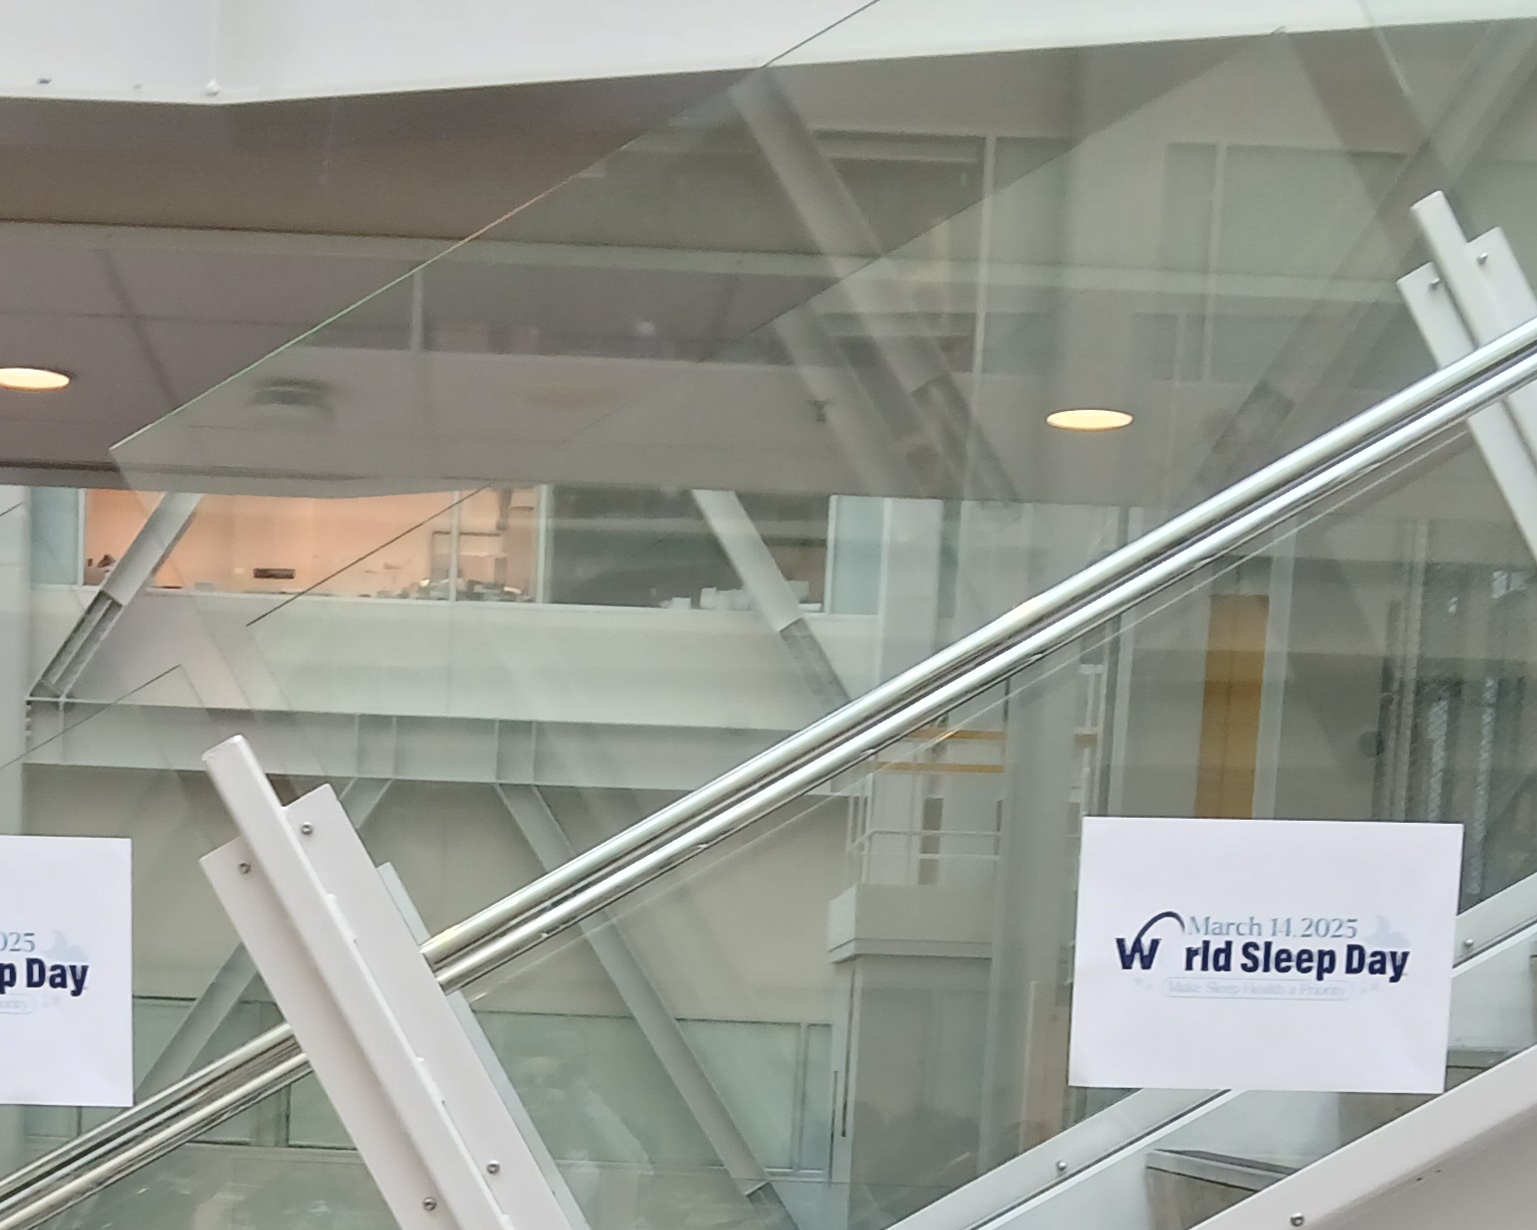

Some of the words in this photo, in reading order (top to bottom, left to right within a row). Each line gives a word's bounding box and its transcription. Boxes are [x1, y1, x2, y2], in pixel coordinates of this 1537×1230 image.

[1187, 915, 1263, 937] March
[25, 957, 90, 997] Day
[1240, 940, 1337, 982] Sleep
[1344, 943, 1411, 983] Day
